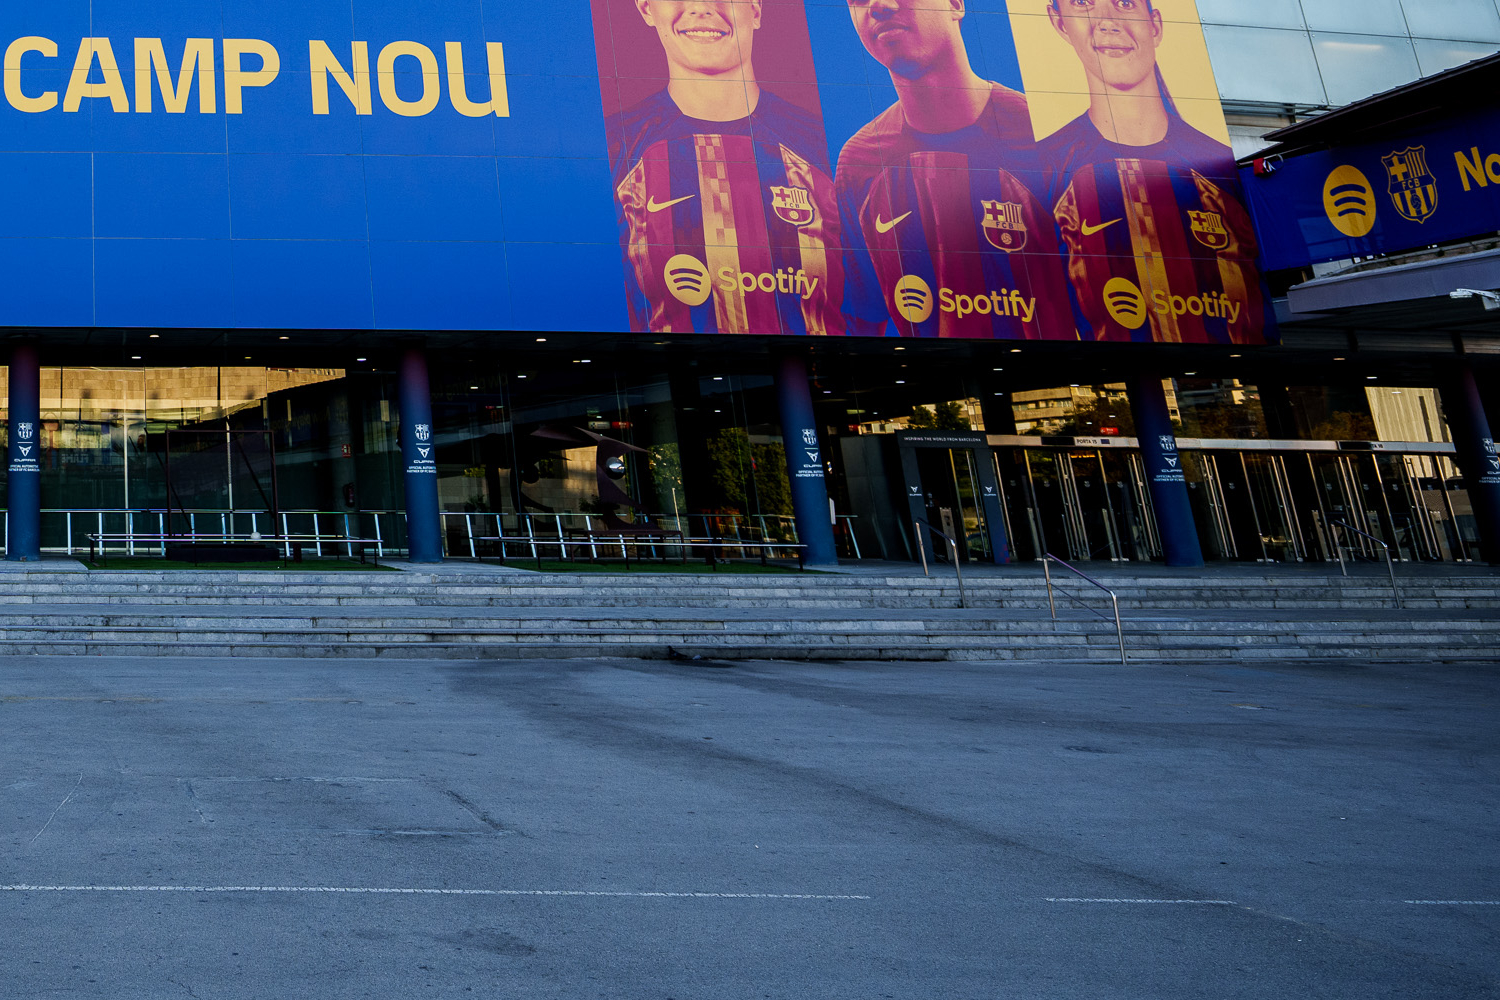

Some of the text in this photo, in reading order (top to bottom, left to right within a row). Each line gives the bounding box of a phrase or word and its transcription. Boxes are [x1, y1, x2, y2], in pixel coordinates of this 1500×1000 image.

[3, 36, 281, 114] CAMP
[308, 39, 511, 118] NOU
[1401, 178, 1421, 190] FCB
[995, 221, 1014, 230] FCB
[717, 265, 819, 301] Spotify
[938, 286, 1036, 324] Spotify
[1151, 288, 1241, 325] Spotify
